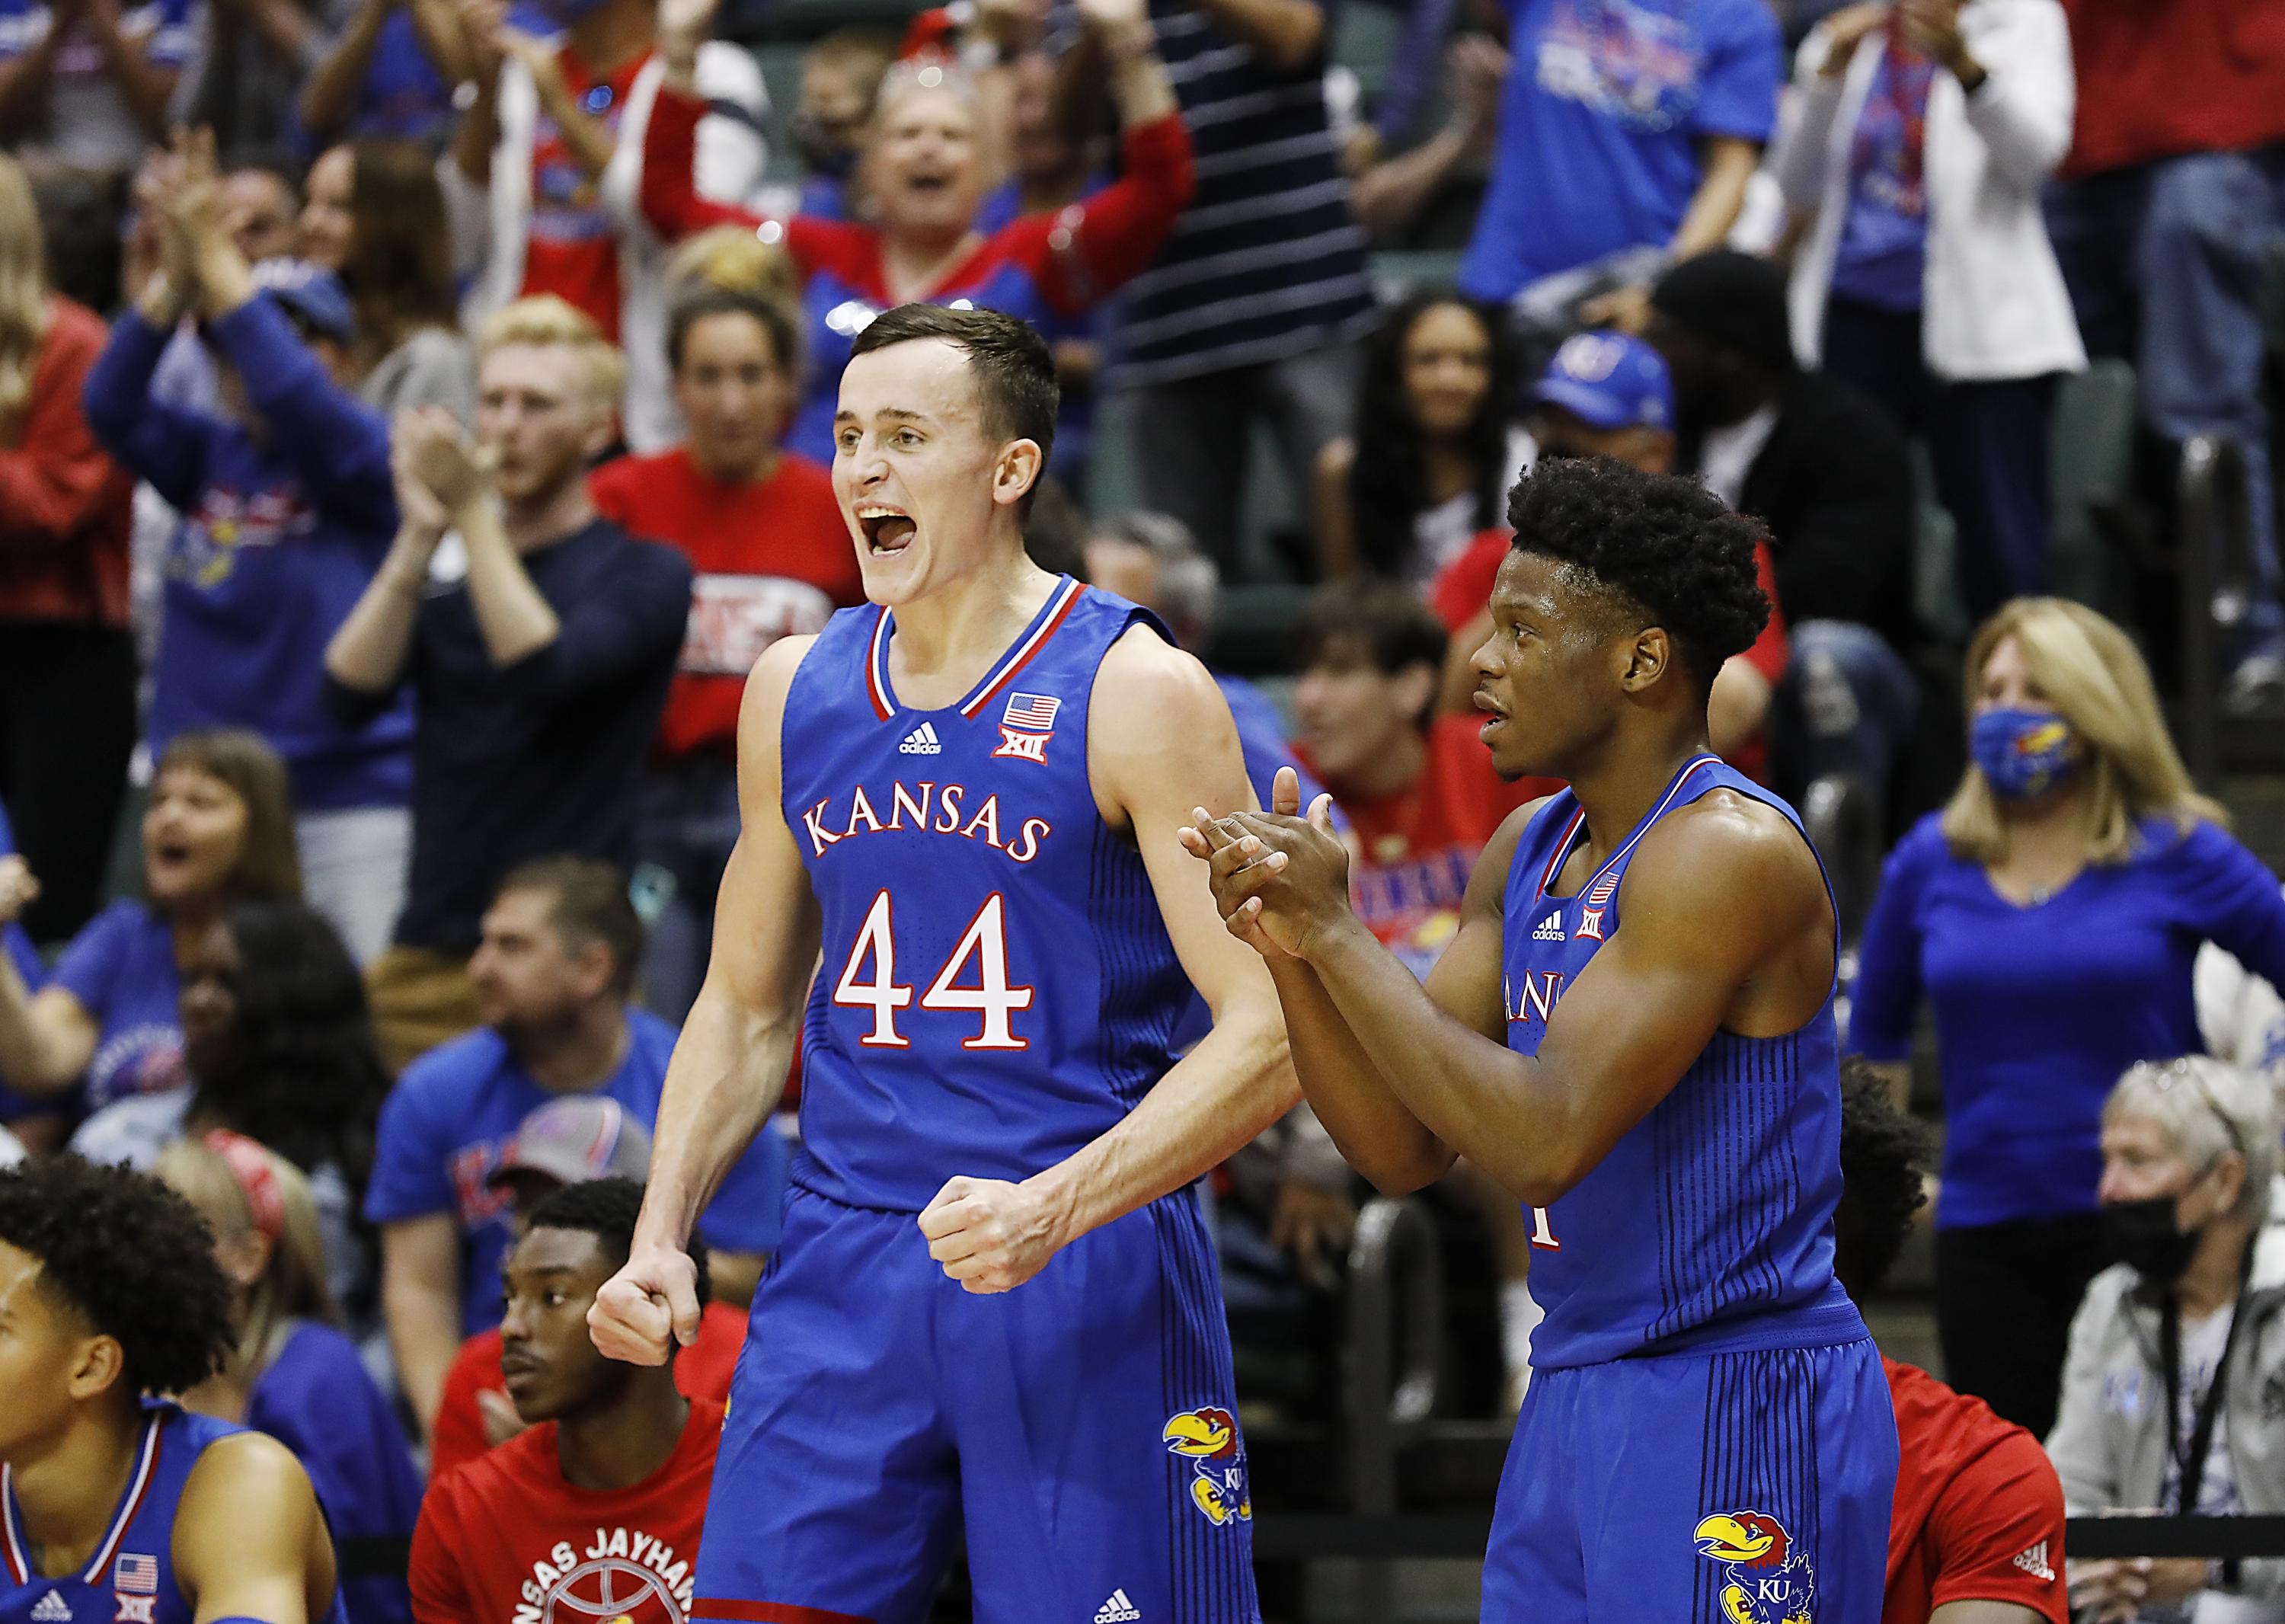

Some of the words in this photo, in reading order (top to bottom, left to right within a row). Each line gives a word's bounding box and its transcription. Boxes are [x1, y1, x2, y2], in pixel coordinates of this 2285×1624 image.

[899, 742, 941, 755] adidas
[991, 724, 1054, 766] XII
[802, 780, 1051, 862] KANSAS
[1532, 929, 1565, 941] adidas
[1573, 904, 1606, 943] XII
[833, 887, 1035, 1050] 44
[1224, 1469, 1242, 1491] KU
[1757, 1578, 1791, 1604] KU
[1094, 1609, 1141, 1624] adidas
